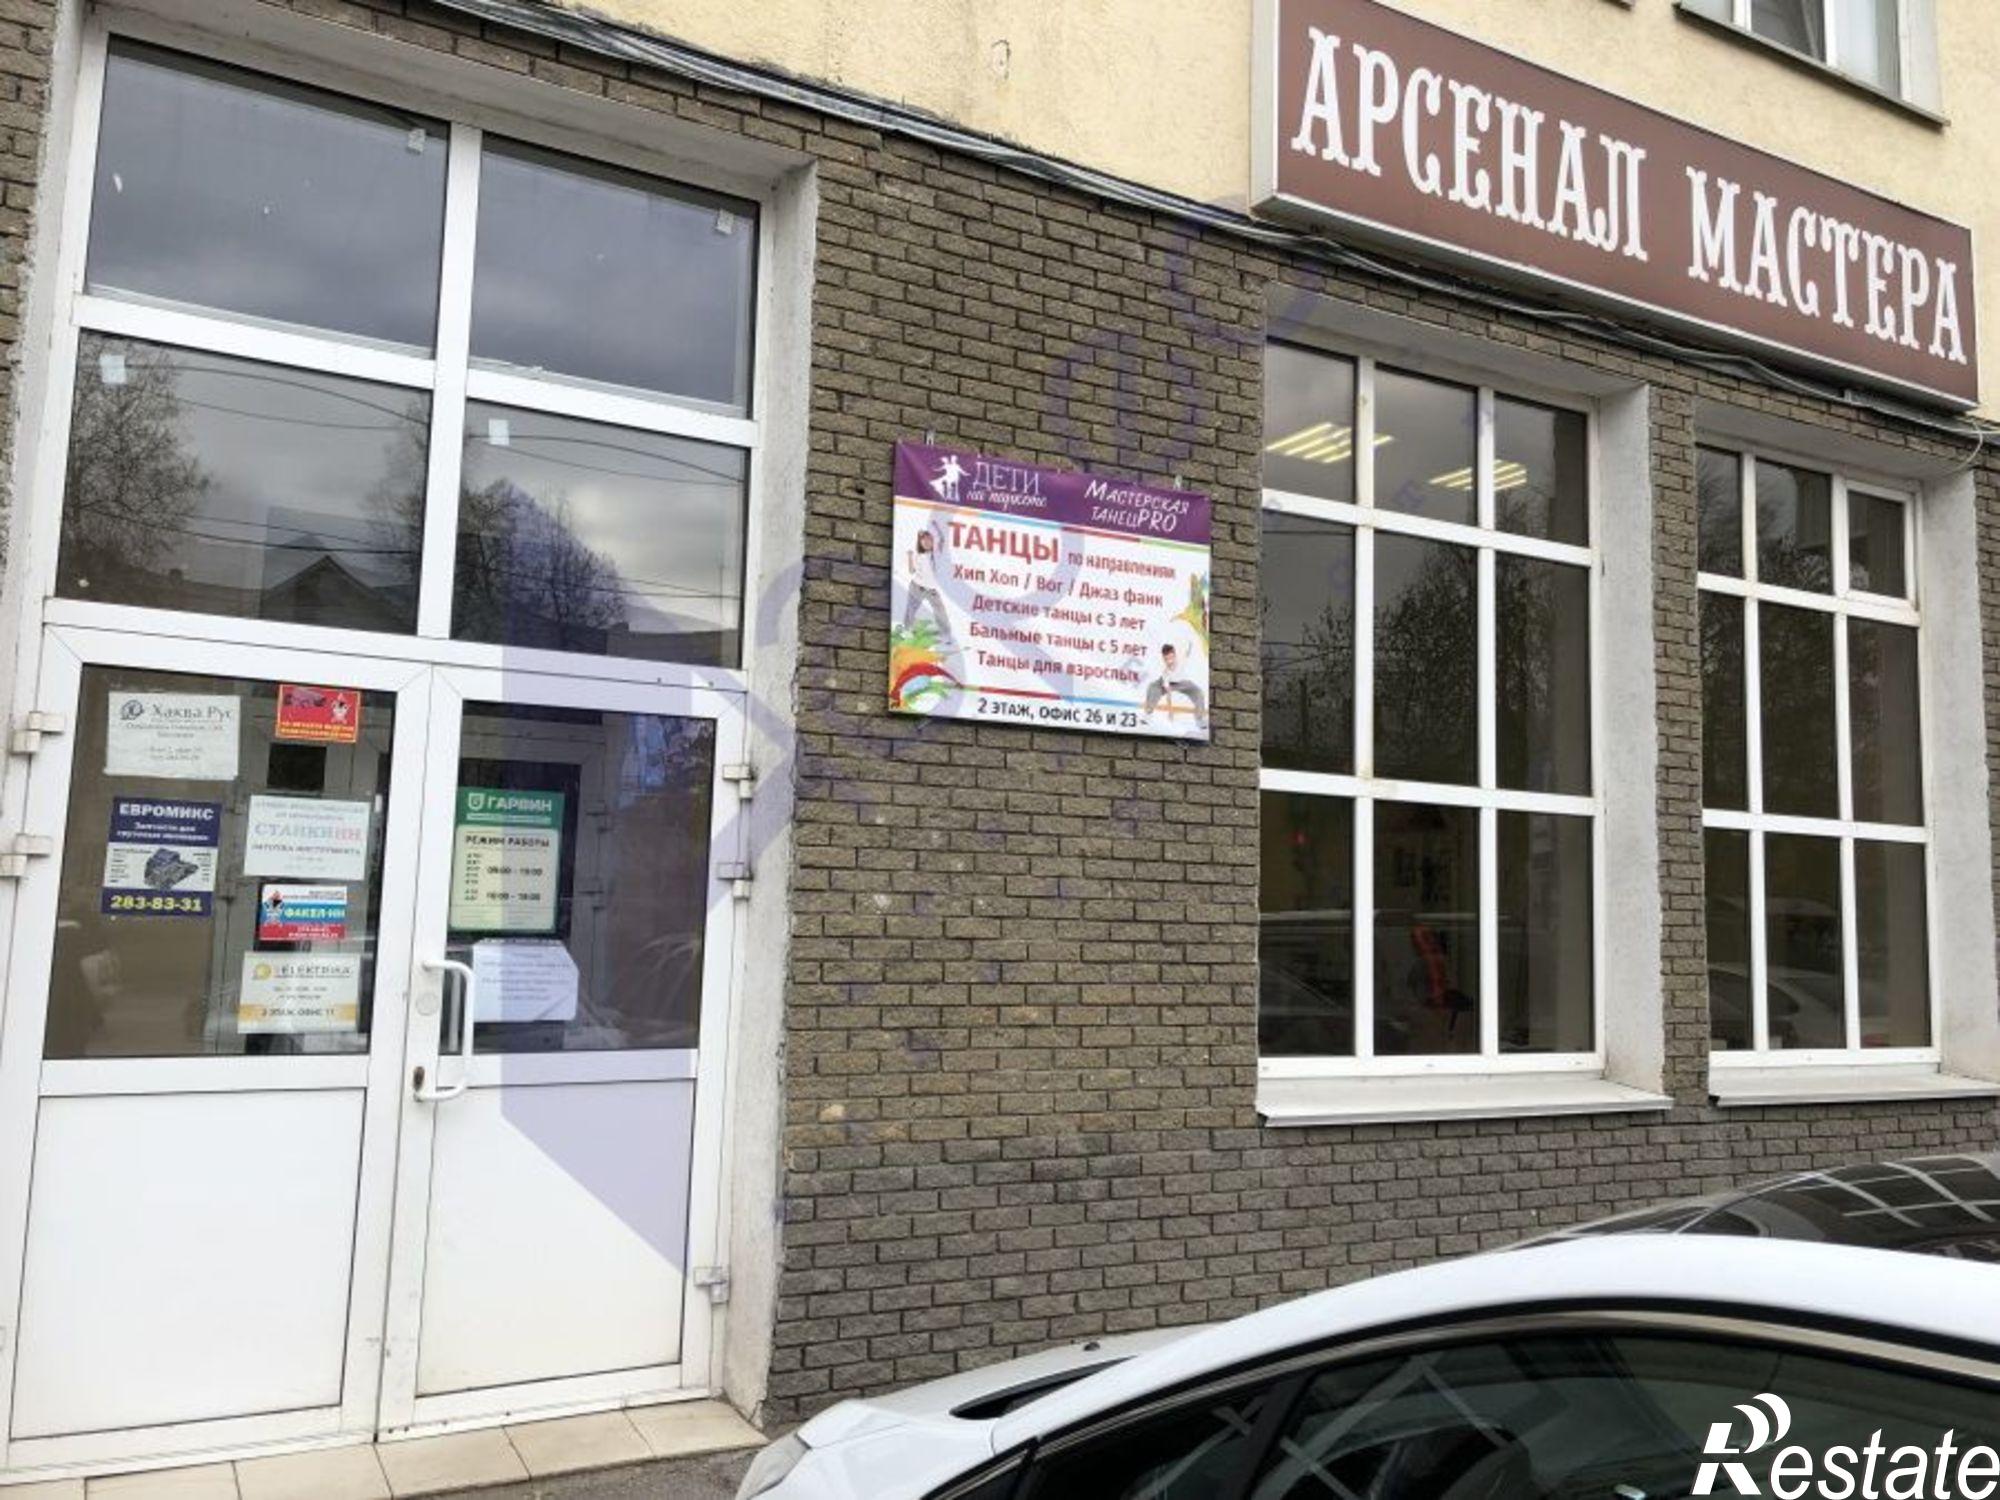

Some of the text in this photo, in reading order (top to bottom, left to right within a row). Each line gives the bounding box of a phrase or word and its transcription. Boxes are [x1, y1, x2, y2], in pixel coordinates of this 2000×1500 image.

[1290, 25, 1968, 365] АРСЕНАЛ МАСТЕРА
[972, 461, 1039, 494] ДЕТИ
[947, 521, 1176, 580] ТАНЦЫ по направлениям
[953, 564, 986, 582] Хип
[990, 567, 1018, 587] Хоп
[1036, 576, 1063, 593] Вог
[1079, 582, 1118, 601] Джаз
[1123, 588, 1163, 607] фанк
[972, 594, 1146, 631] Детские танцы с 3 лет
[970, 622, 1147, 657] Бальные танцы с 5 лет
[977, 650, 1140, 683] Танцы для взрослых
[977, 698, 1136, 728] 2 ЭТАЖ, ОФИС 26 И 23
[119, 803, 214, 820] ЕВРОМИКС
[487, 796, 552, 812] ГАРВИН
[110, 895, 202, 912] 283-83-31
